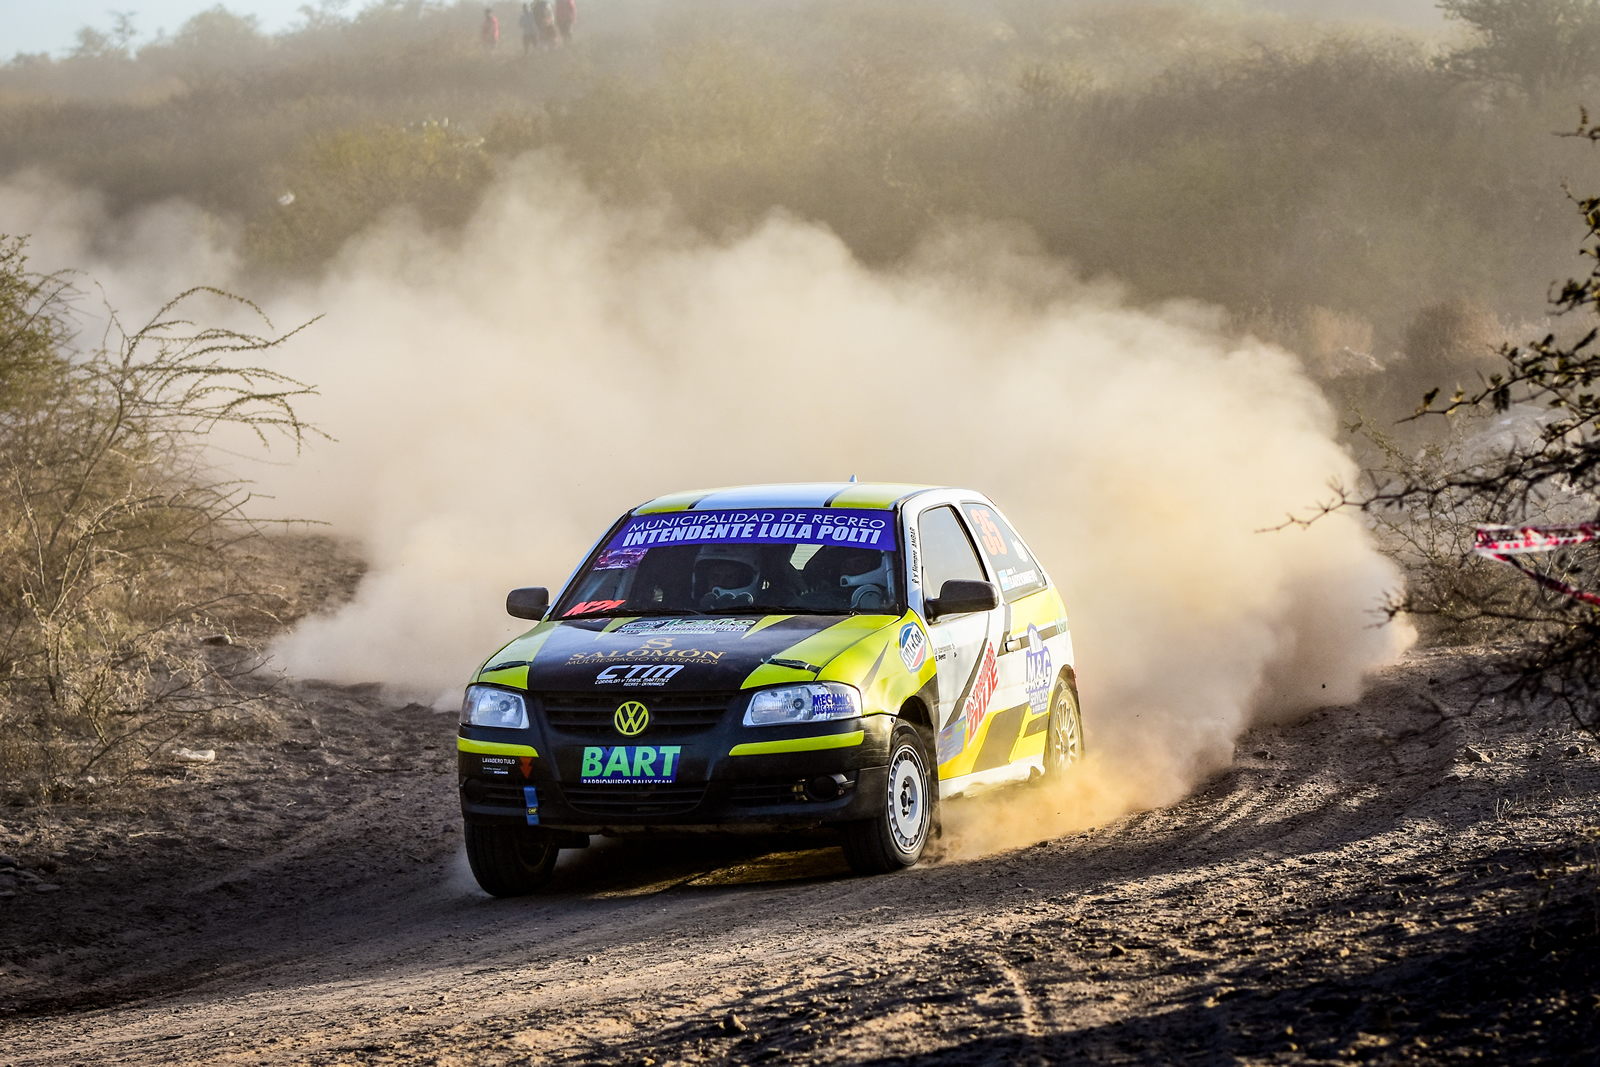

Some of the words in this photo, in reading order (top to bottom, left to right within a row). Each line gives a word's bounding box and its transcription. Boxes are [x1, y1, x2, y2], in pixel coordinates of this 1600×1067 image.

[628, 513, 775, 532] MUNICIPALIDAD
[781, 513, 807, 523] DE
[812, 514, 886, 529] RECREO
[970, 508, 1008, 556] 35
[622, 523, 756, 547] INTENDENTE
[757, 523, 813, 539] LULA
[816, 525, 882, 544] POLTI
[565, 657, 649, 666] MULTIESPACIO
[663, 657, 720, 665] EVENTOS
[569, 649, 727, 660] SALOMÓN
[596, 664, 685, 679] CTM
[1026, 649, 1052, 687] M&G
[614, 701, 649, 736] VW
[581, 746, 682, 777] BART
